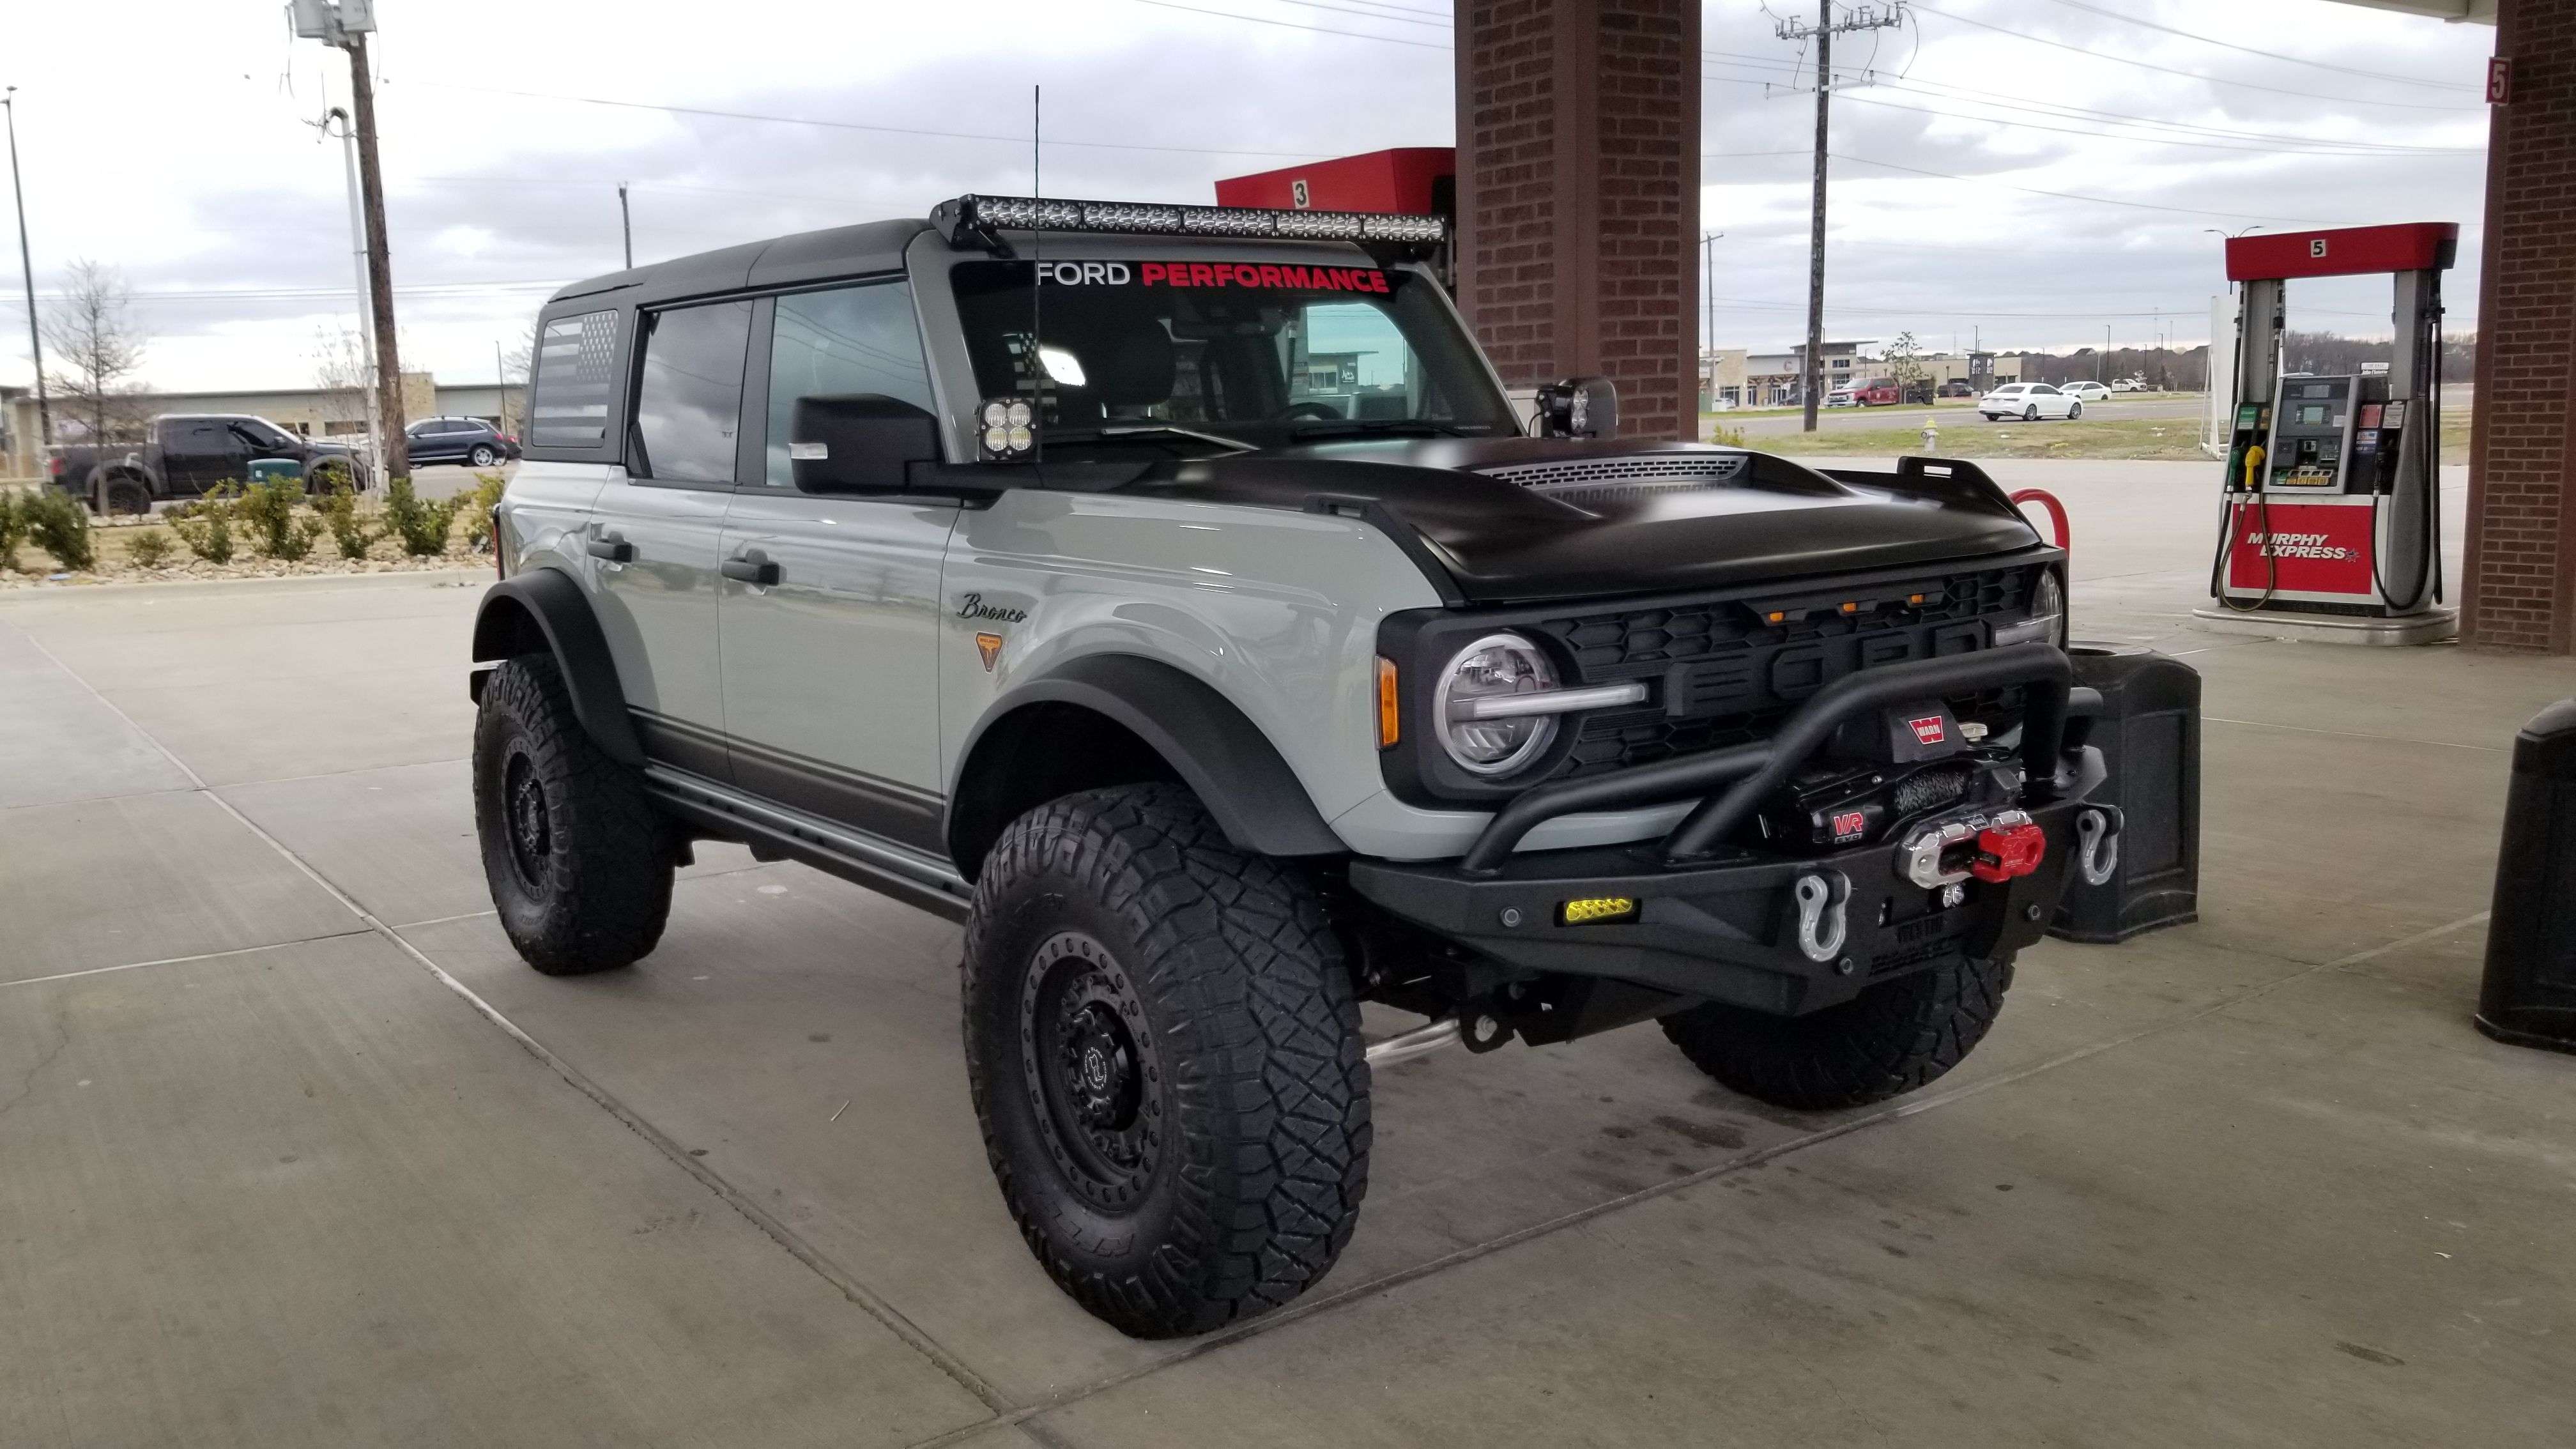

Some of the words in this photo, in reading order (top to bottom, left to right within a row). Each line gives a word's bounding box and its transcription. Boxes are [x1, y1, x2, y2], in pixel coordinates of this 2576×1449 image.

[2492, 63, 2506, 99] 5
[1295, 183, 1307, 206] 3
[2313, 241, 2324, 256] 5
[1038, 262, 1131, 286] FORD
[1141, 263, 1390, 293] PERFORMANCE
[956, 592, 1028, 624] Bronco
[1917, 724, 1941, 737] WARN
[1833, 811, 1864, 836] VR
[1836, 834, 1860, 843] EVO
